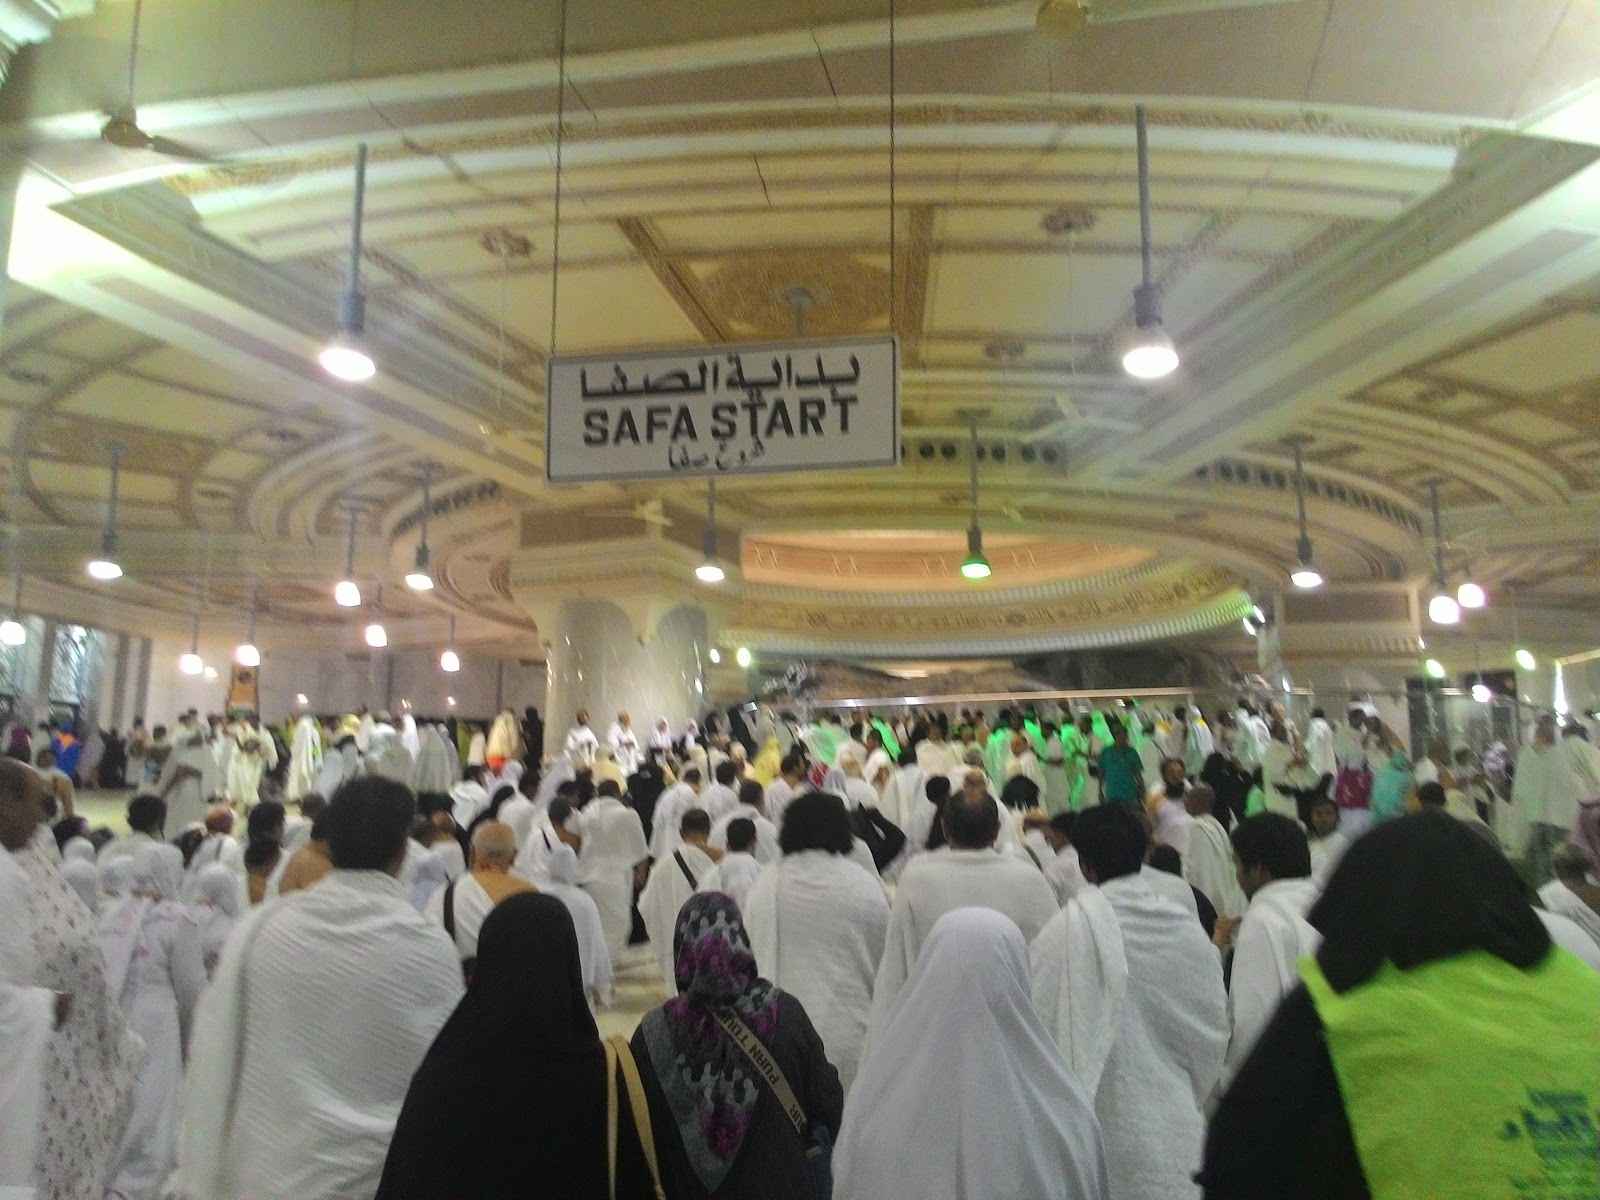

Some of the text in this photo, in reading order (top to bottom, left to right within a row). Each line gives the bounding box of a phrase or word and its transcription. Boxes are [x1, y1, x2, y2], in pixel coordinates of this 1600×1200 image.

[581, 352, 861, 401] بداية الصفا
[582, 393, 859, 447] SAFA START
